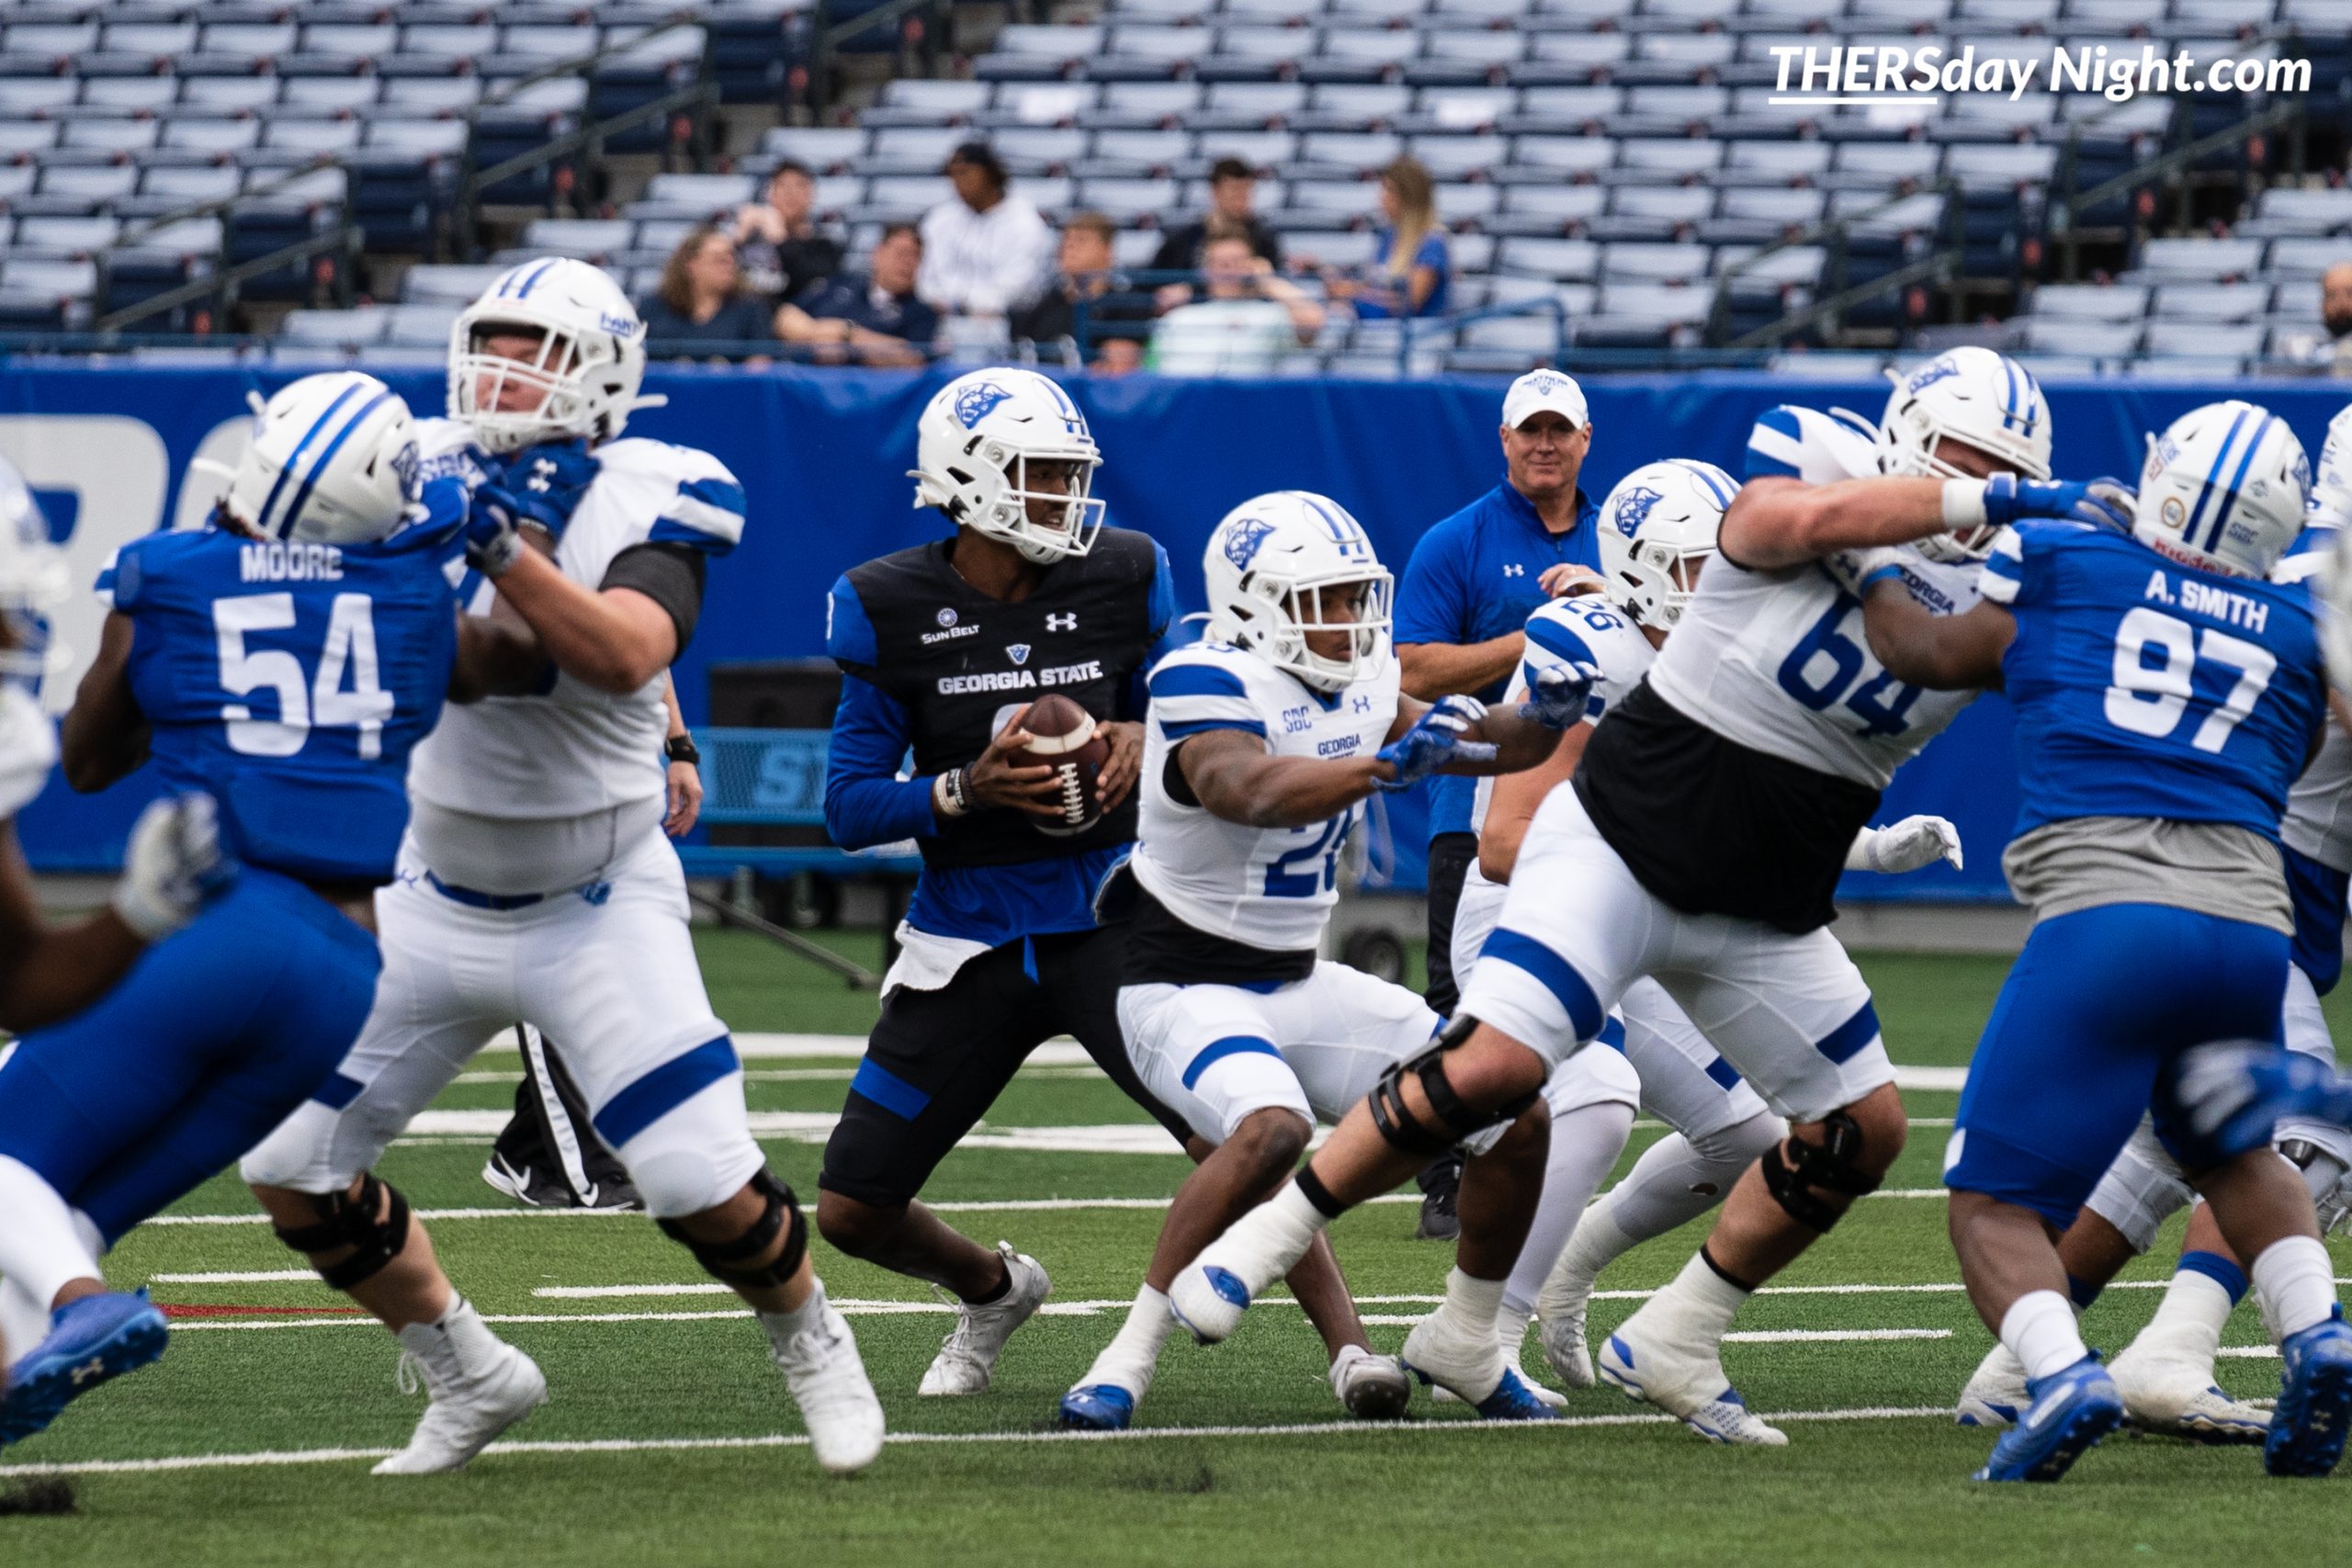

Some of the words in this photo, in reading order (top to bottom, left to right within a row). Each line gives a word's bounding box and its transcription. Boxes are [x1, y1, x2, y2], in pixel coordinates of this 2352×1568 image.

[240, 544, 345, 582] MOORE
[1899, 562, 1955, 615] EORGIA
[2144, 570, 2176, 604] A.
[2180, 579, 2269, 635] SMITH
[922, 630, 950, 644] SUN
[951, 624, 980, 638] BELT
[1561, 599, 1624, 632] 26
[212, 592, 395, 760] 54
[938, 670, 1036, 695] GEORGIA
[1040, 660, 1103, 686] STATE
[1778, 590, 1923, 739] 64
[1317, 732, 1362, 757] GEORGIA
